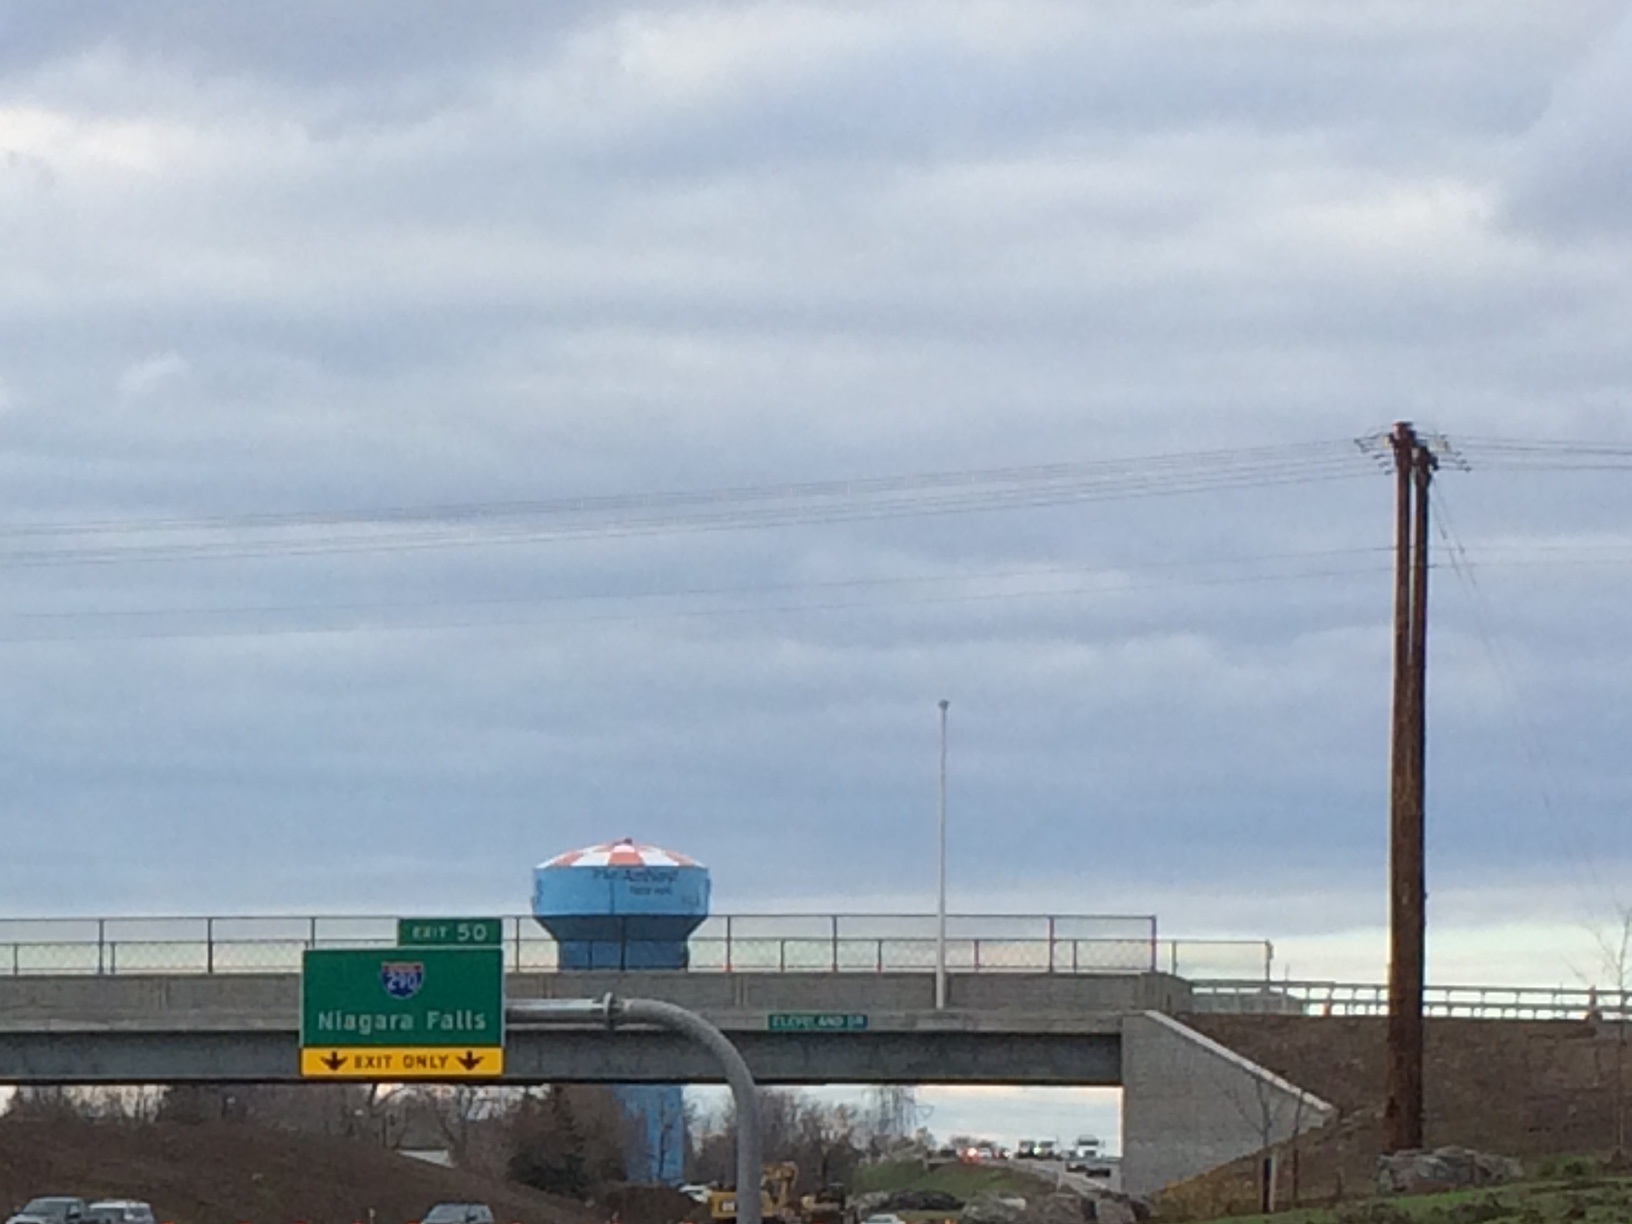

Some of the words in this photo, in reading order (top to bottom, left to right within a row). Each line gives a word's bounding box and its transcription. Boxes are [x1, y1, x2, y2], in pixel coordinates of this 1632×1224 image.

[412, 927, 447, 939] EXIT
[457, 923, 488, 942] 50
[386, 972, 418, 991] 290
[318, 1010, 414, 1035] Niagara
[427, 1010, 487, 1031] Falls
[354, 1055, 392, 1069] EXIT
[402, 1055, 450, 1069] ONLY
